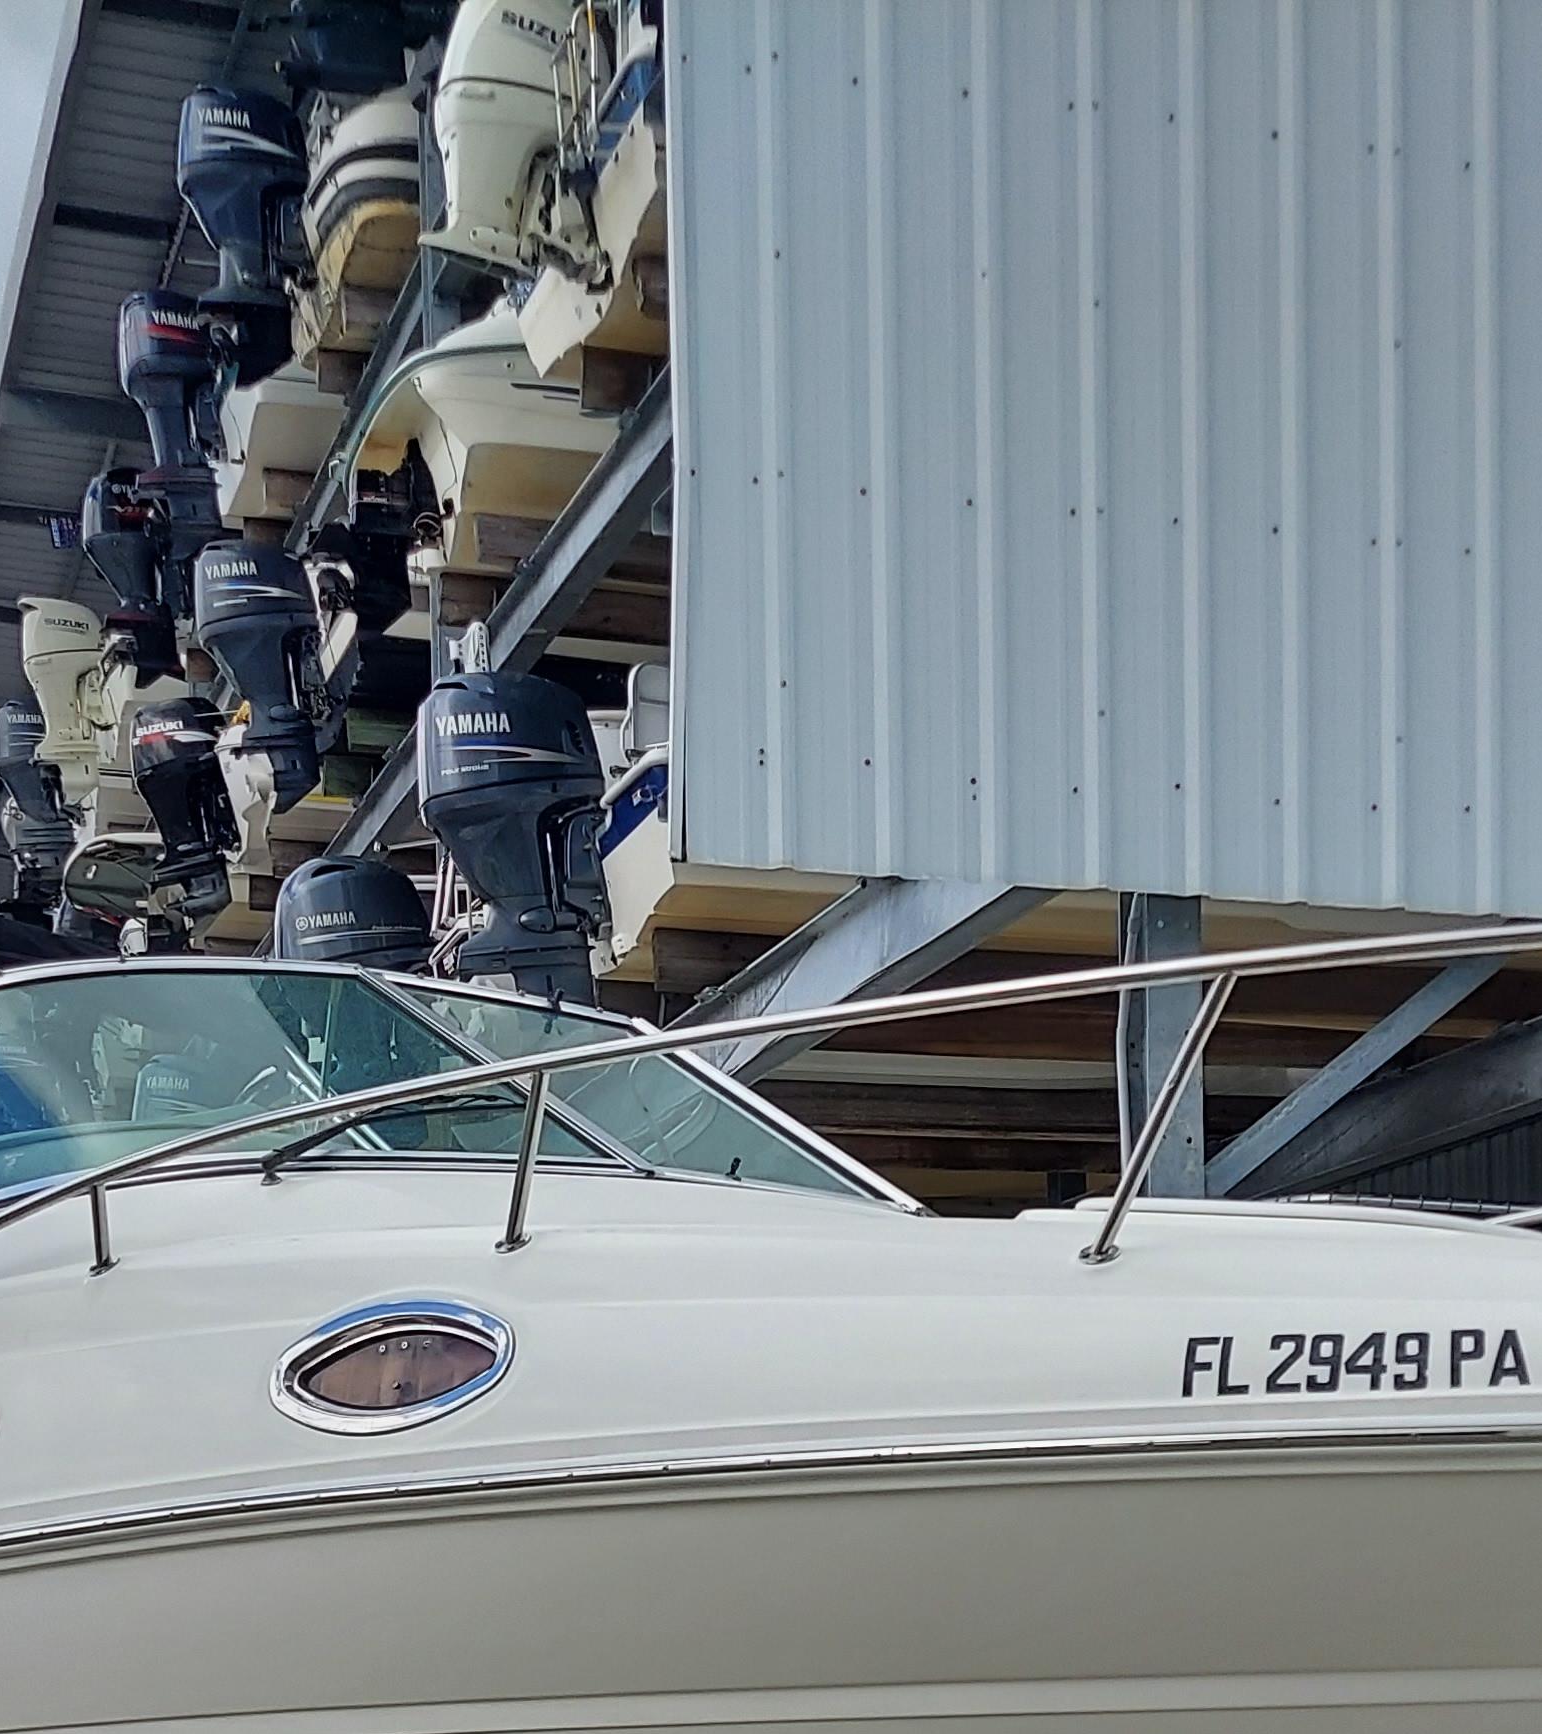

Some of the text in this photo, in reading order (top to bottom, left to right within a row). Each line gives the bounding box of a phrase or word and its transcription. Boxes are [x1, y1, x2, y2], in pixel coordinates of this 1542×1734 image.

[197, 107, 251, 129] YAMAHA
[151, 309, 200, 331] YAMAHA
[204, 560, 258, 580] YAMAHA
[44, 618, 89, 631] SUZUKI
[136, 720, 184, 737] SUZUKI
[435, 712, 511, 737] YAMAHA
[308, 910, 356, 929] YAMAHA
[146, 1076, 190, 1091] YAMAHA
[1182, 1329, 1531, 1398] FL 2949 PA
